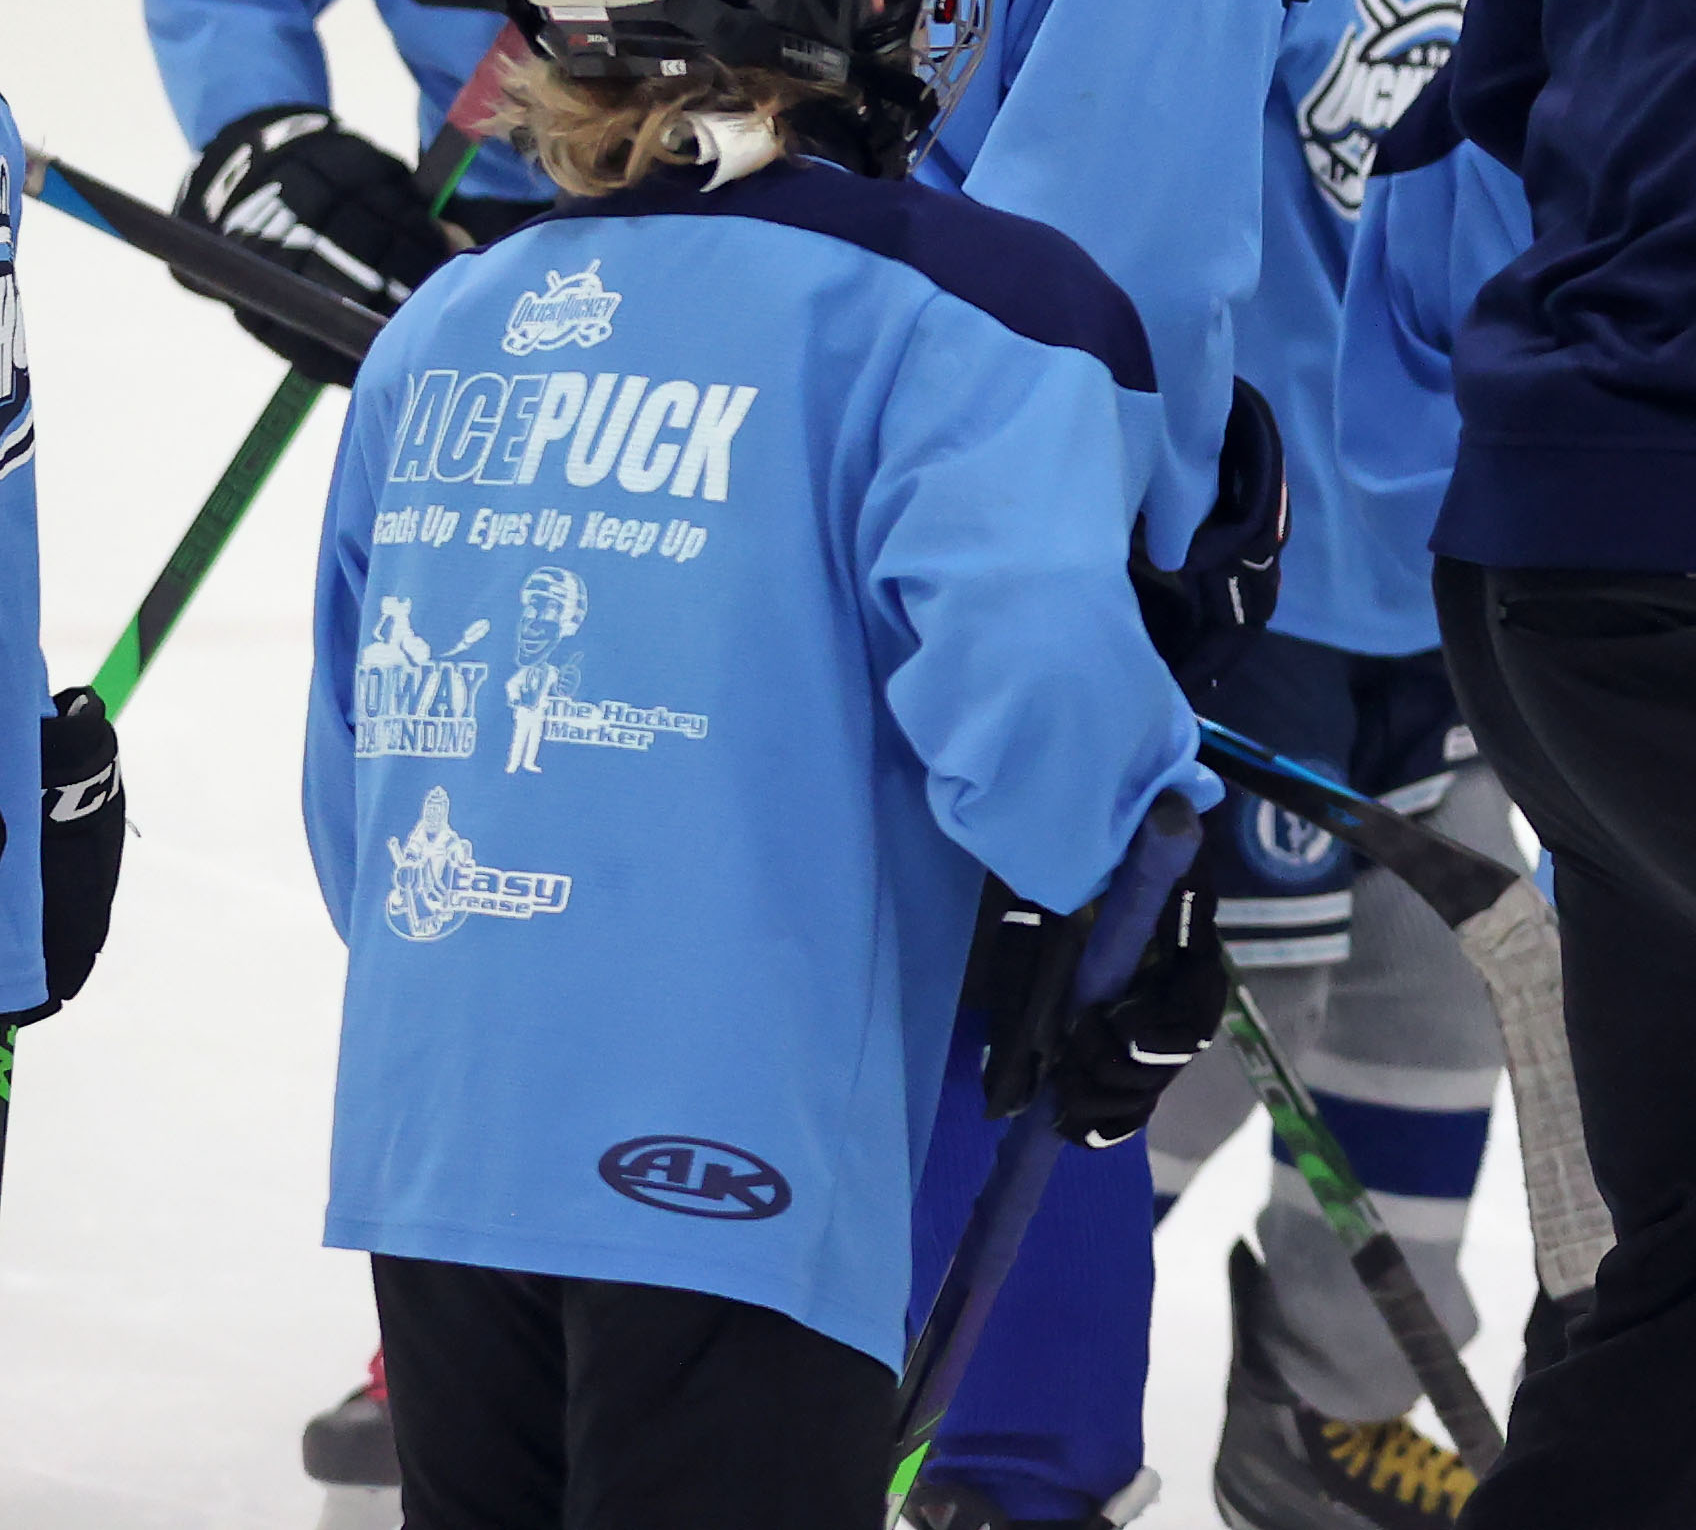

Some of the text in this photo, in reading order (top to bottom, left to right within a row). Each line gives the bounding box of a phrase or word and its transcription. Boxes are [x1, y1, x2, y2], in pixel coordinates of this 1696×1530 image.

[390, 370, 760, 503] ACEPUCK
[421, 505, 460, 548] Up
[468, 507, 533, 551] Eyes
[532, 509, 573, 552] Up
[579, 510, 660, 558] Keep
[659, 519, 707, 564] Up
[549, 697, 705, 736] The Hockey
[549, 721, 650, 747] Marker
[451, 871, 566, 909] Easy
